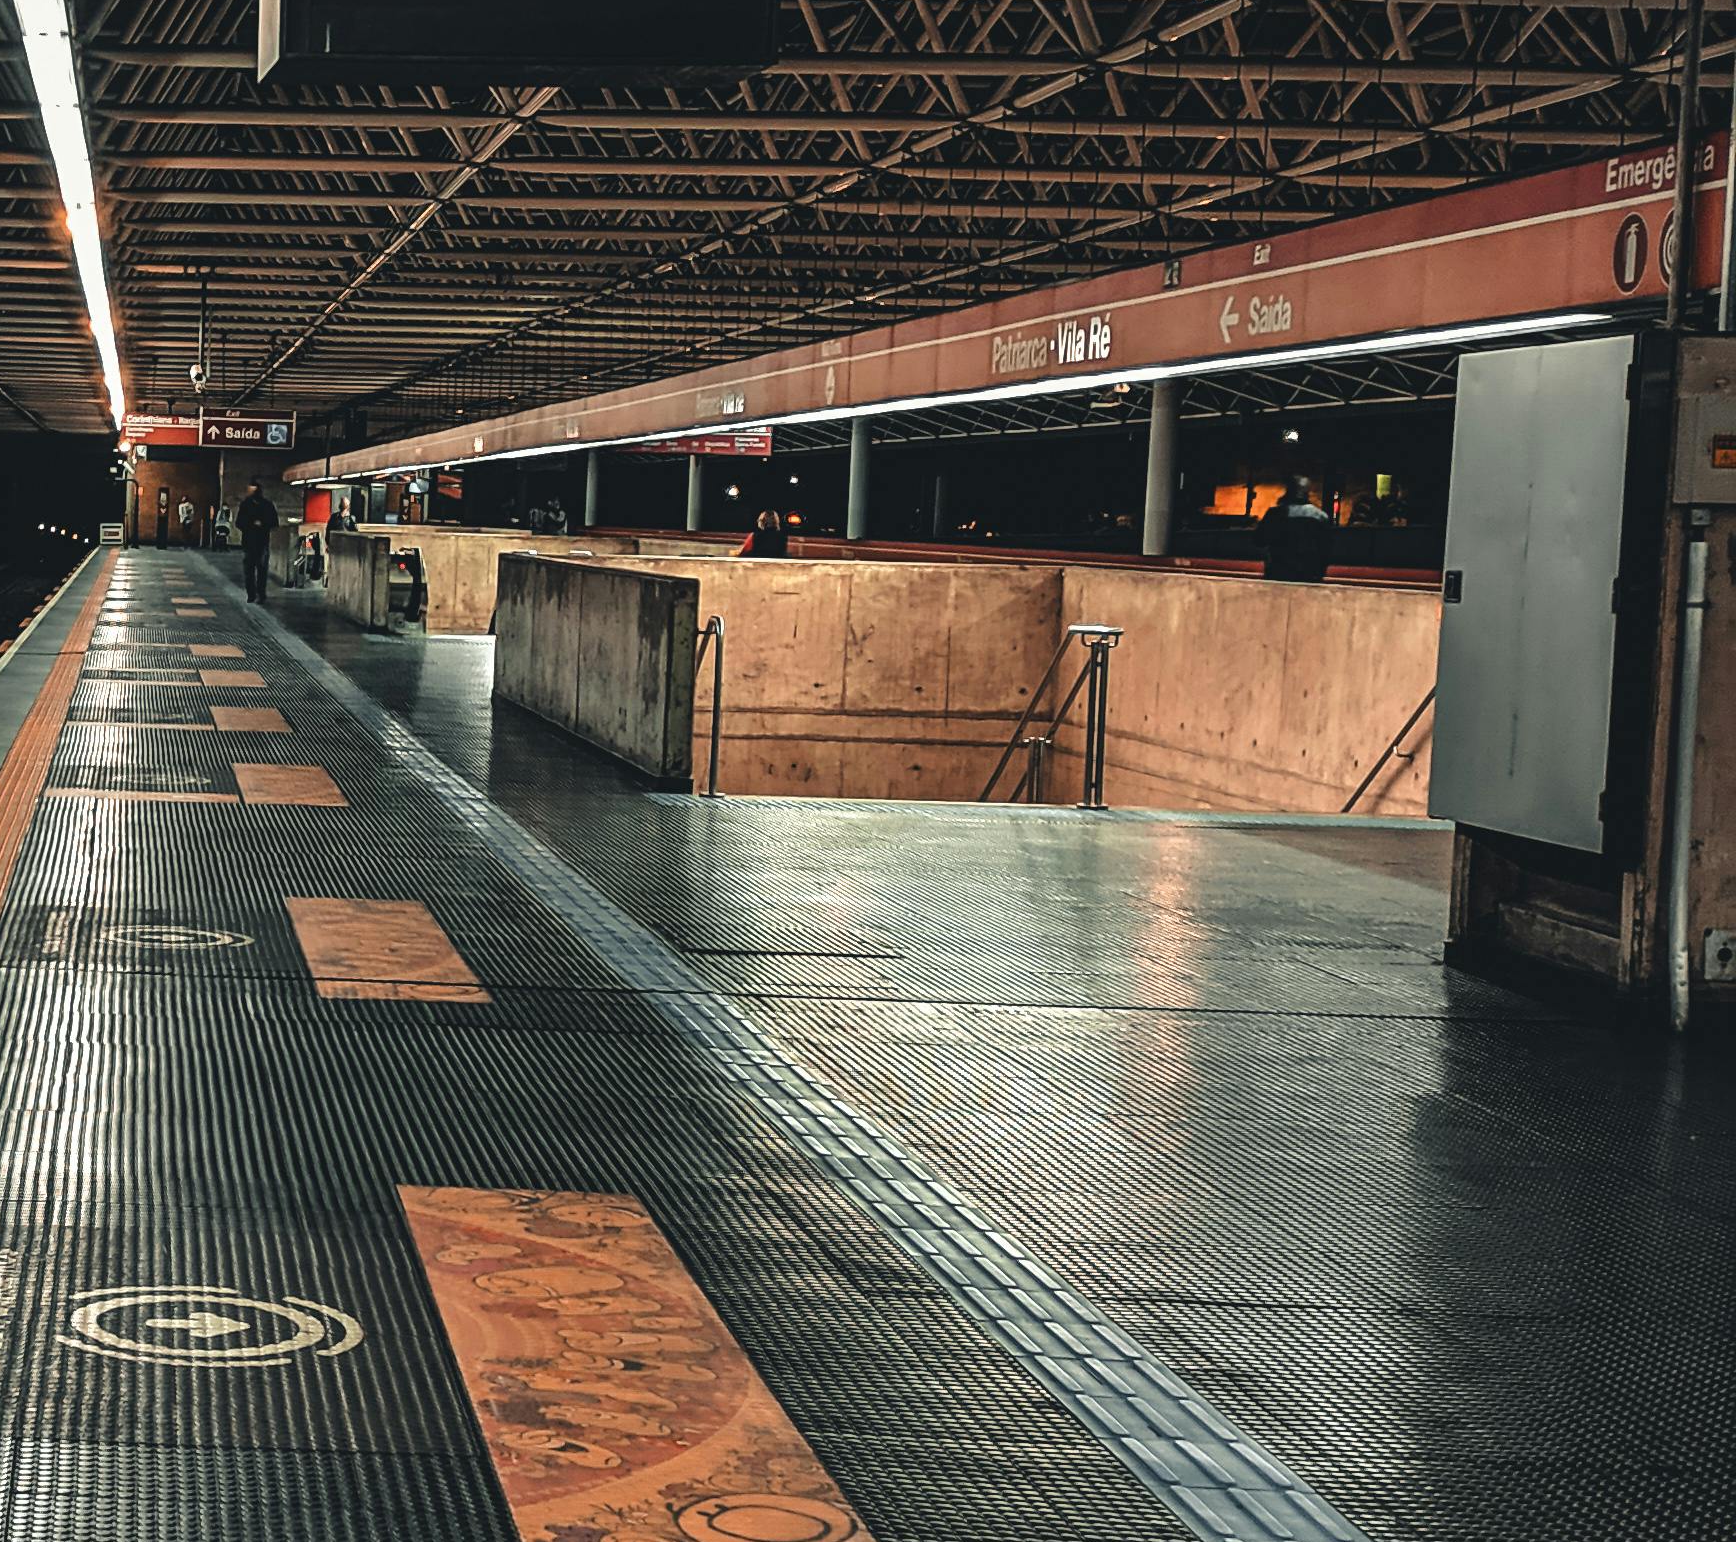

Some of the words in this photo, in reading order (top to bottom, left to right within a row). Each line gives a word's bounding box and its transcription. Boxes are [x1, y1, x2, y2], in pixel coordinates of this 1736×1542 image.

[1248, 294, 1292, 336] Saída
[992, 331, 1047, 374] Patriarca
[1057, 320, 1085, 364] Vila
[1088, 312, 1111, 360] Ré
[225, 427, 261, 440] Saída
